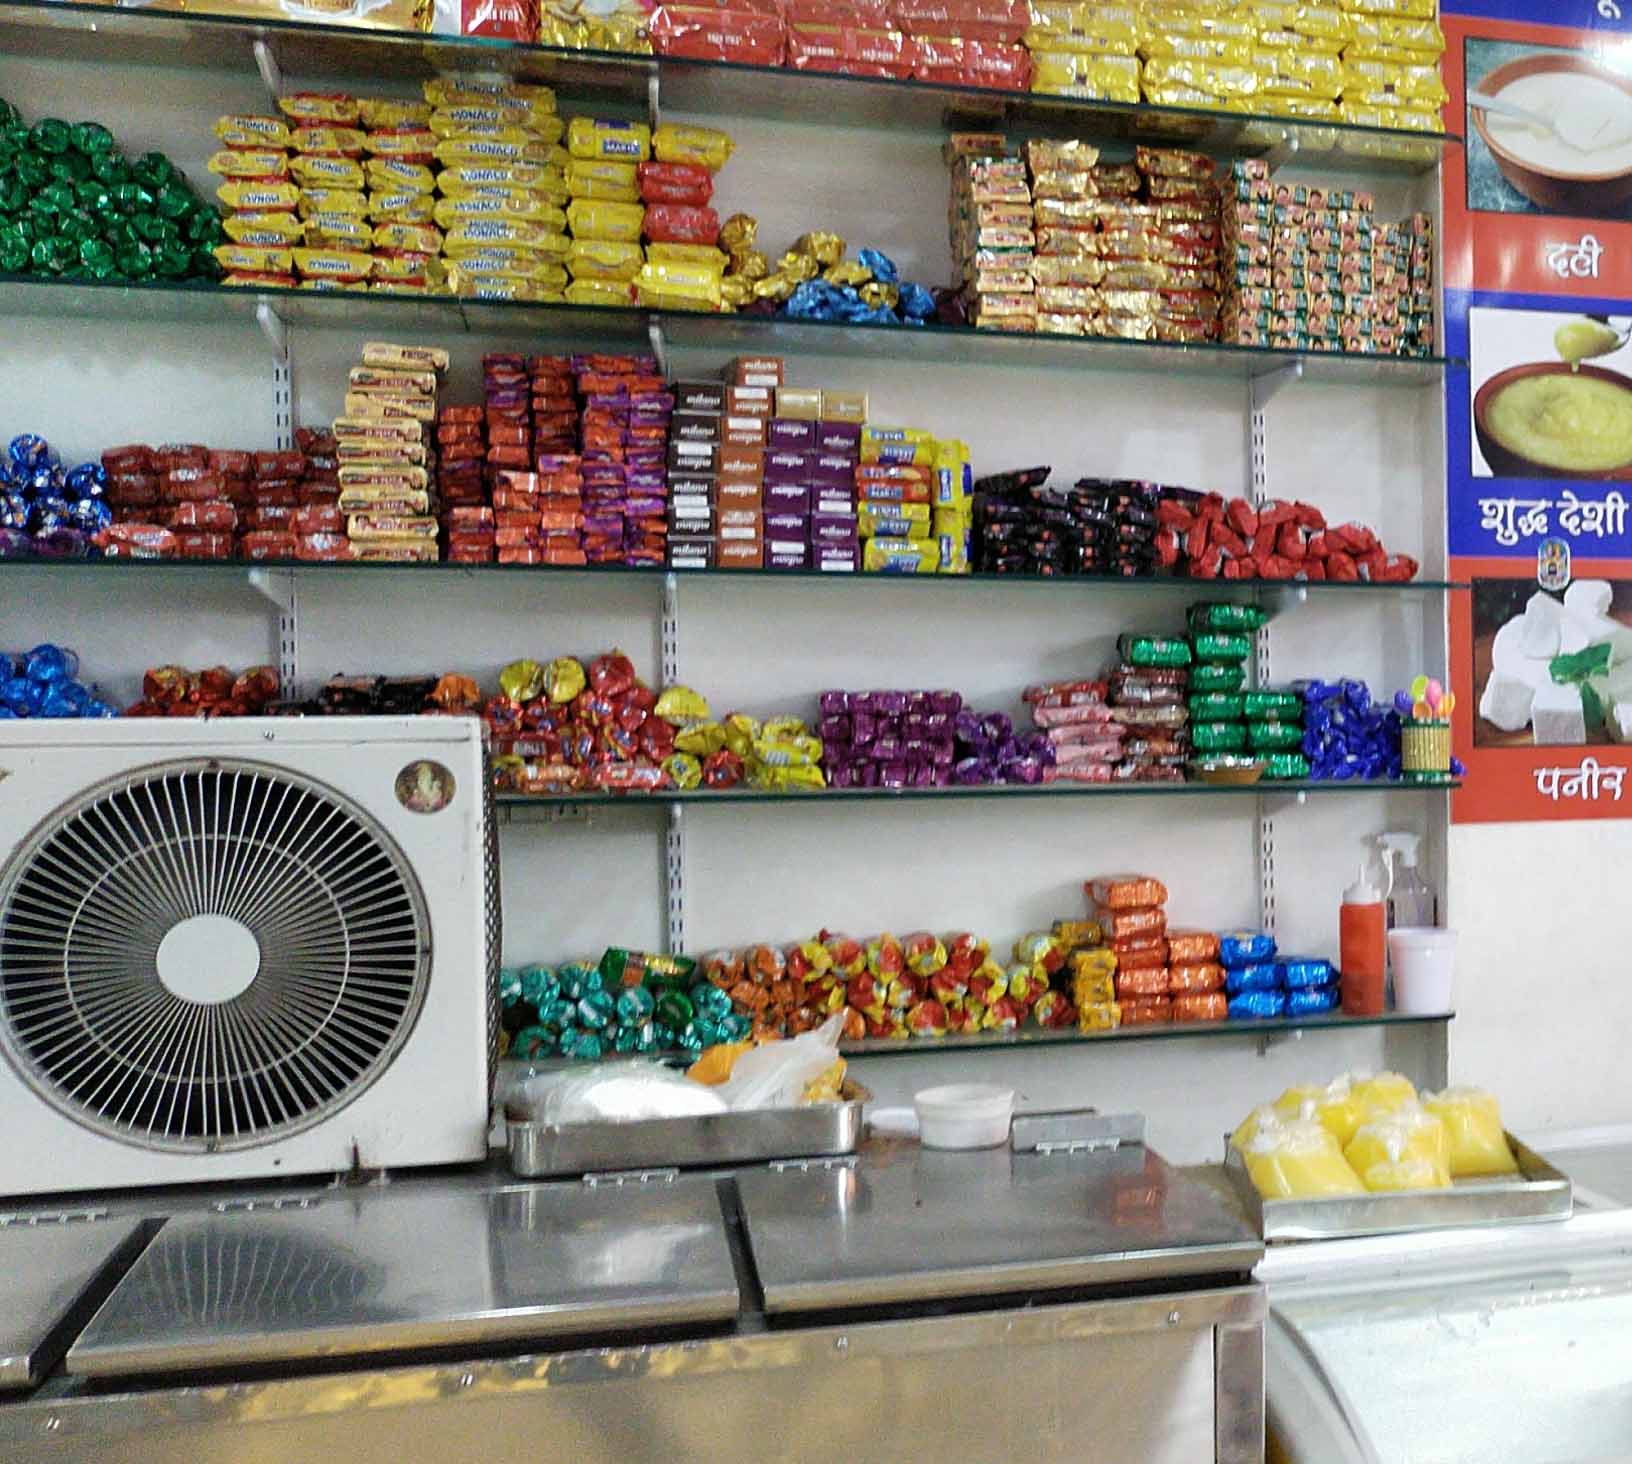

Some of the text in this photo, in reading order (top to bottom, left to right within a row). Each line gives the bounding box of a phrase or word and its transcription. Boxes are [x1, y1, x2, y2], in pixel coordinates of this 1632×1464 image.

[450, 110, 499, 121] MONACO
[469, 142, 518, 156] MONACO
[1546, 235, 1604, 278] दही
[686, 393, 721, 405] milano
[680, 424, 715, 436] milano
[673, 481, 708, 493] milano
[1478, 498, 1553, 545] शुद्ध
[1556, 490, 1629, 537] देशी
[672, 544, 707, 556] milano
[1533, 757, 1628, 800] पनीर
